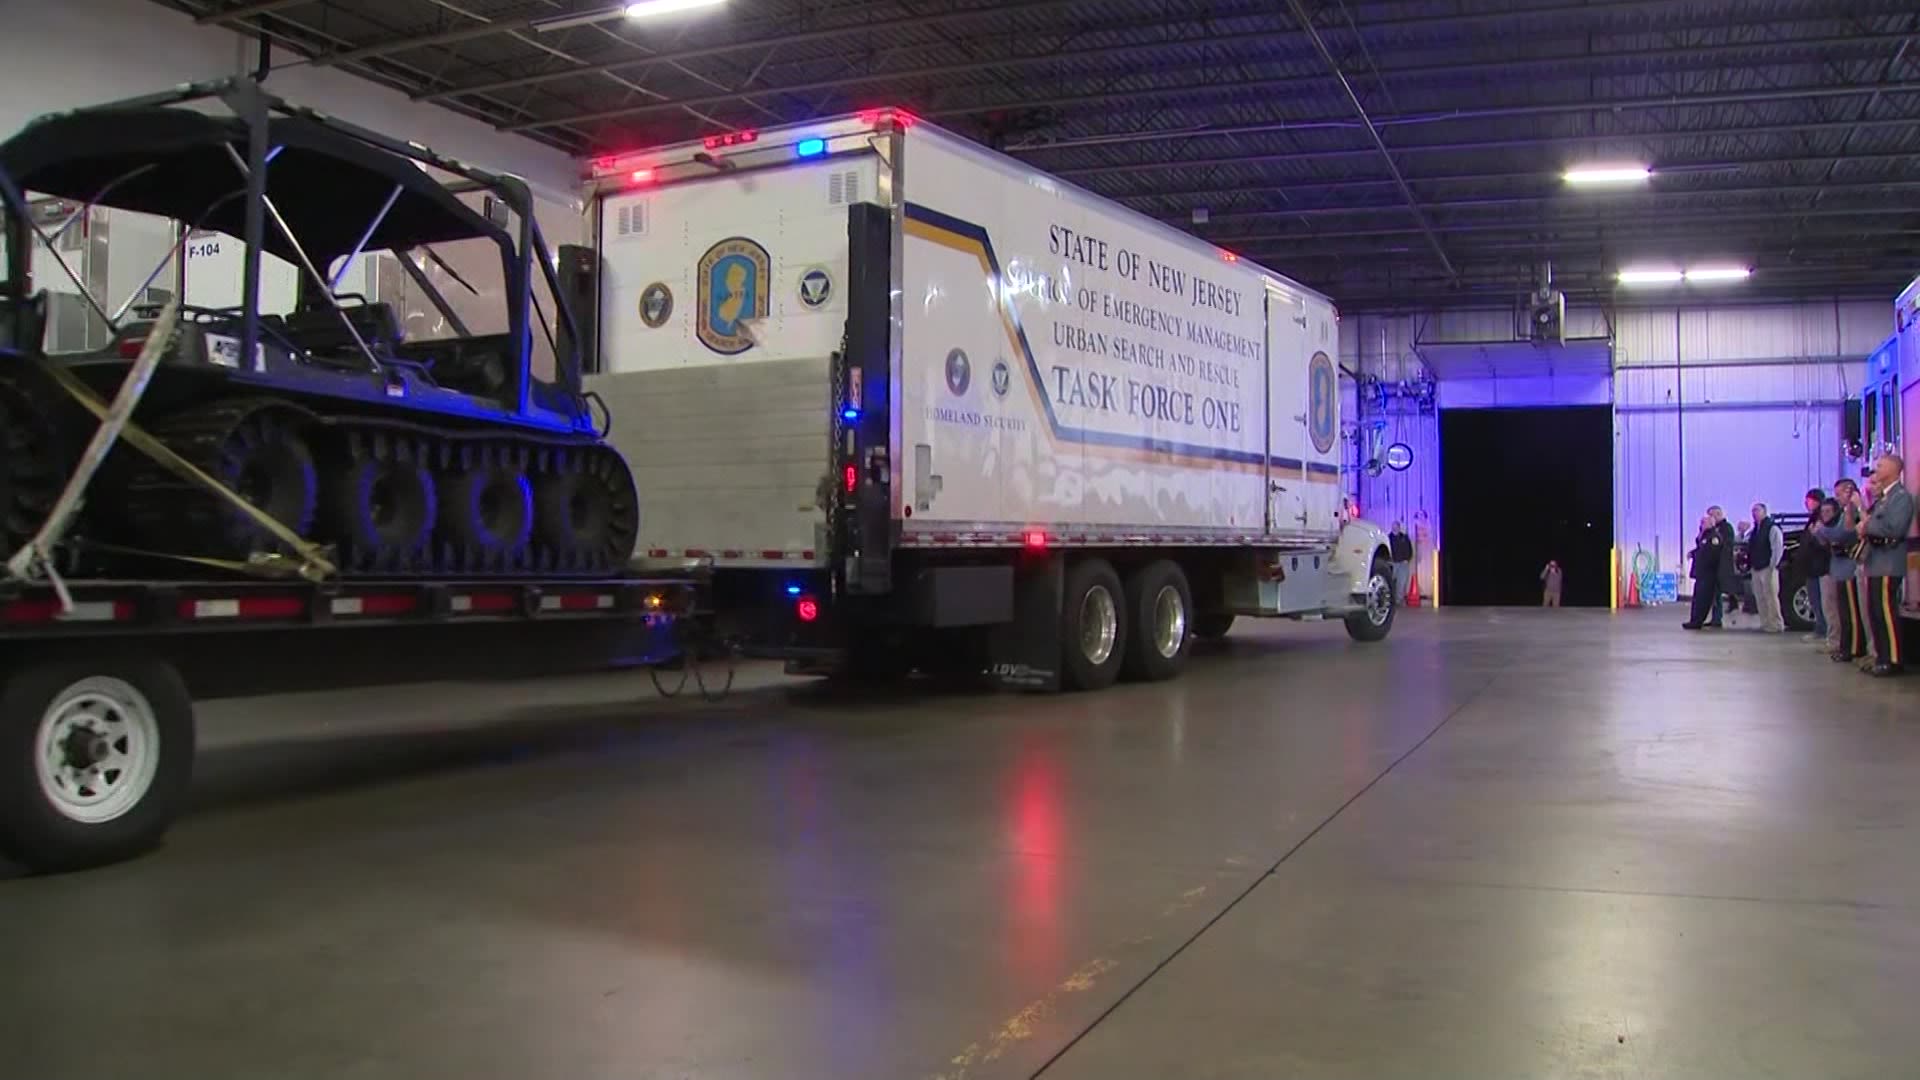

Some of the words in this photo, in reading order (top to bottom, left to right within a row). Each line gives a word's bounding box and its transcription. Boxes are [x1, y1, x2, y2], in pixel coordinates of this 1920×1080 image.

[189, 243, 219, 258] F-104
[1049, 224, 1108, 271] STATE
[1117, 248, 1140, 281] OF
[1149, 260, 1187, 297] NEW
[1192, 277, 1241, 316] JERSEY
[1053, 321, 1109, 355] URBAN
[1113, 336, 1164, 369] SEARCH
[1169, 353, 1195, 376] AND
[1199, 359, 1239, 389] RESCUE
[1078, 288, 1097, 312] OF
[1103, 294, 1183, 337] EMERGENCY
[1187, 321, 1261, 361] MANAGEMENT
[926, 407, 980, 425] HOMELAND
[983, 415, 1026, 431] SECURITY
[1051, 365, 1118, 412] TASK
[1128, 379, 1194, 425] FORCE
[1202, 396, 1240, 432] ONE
